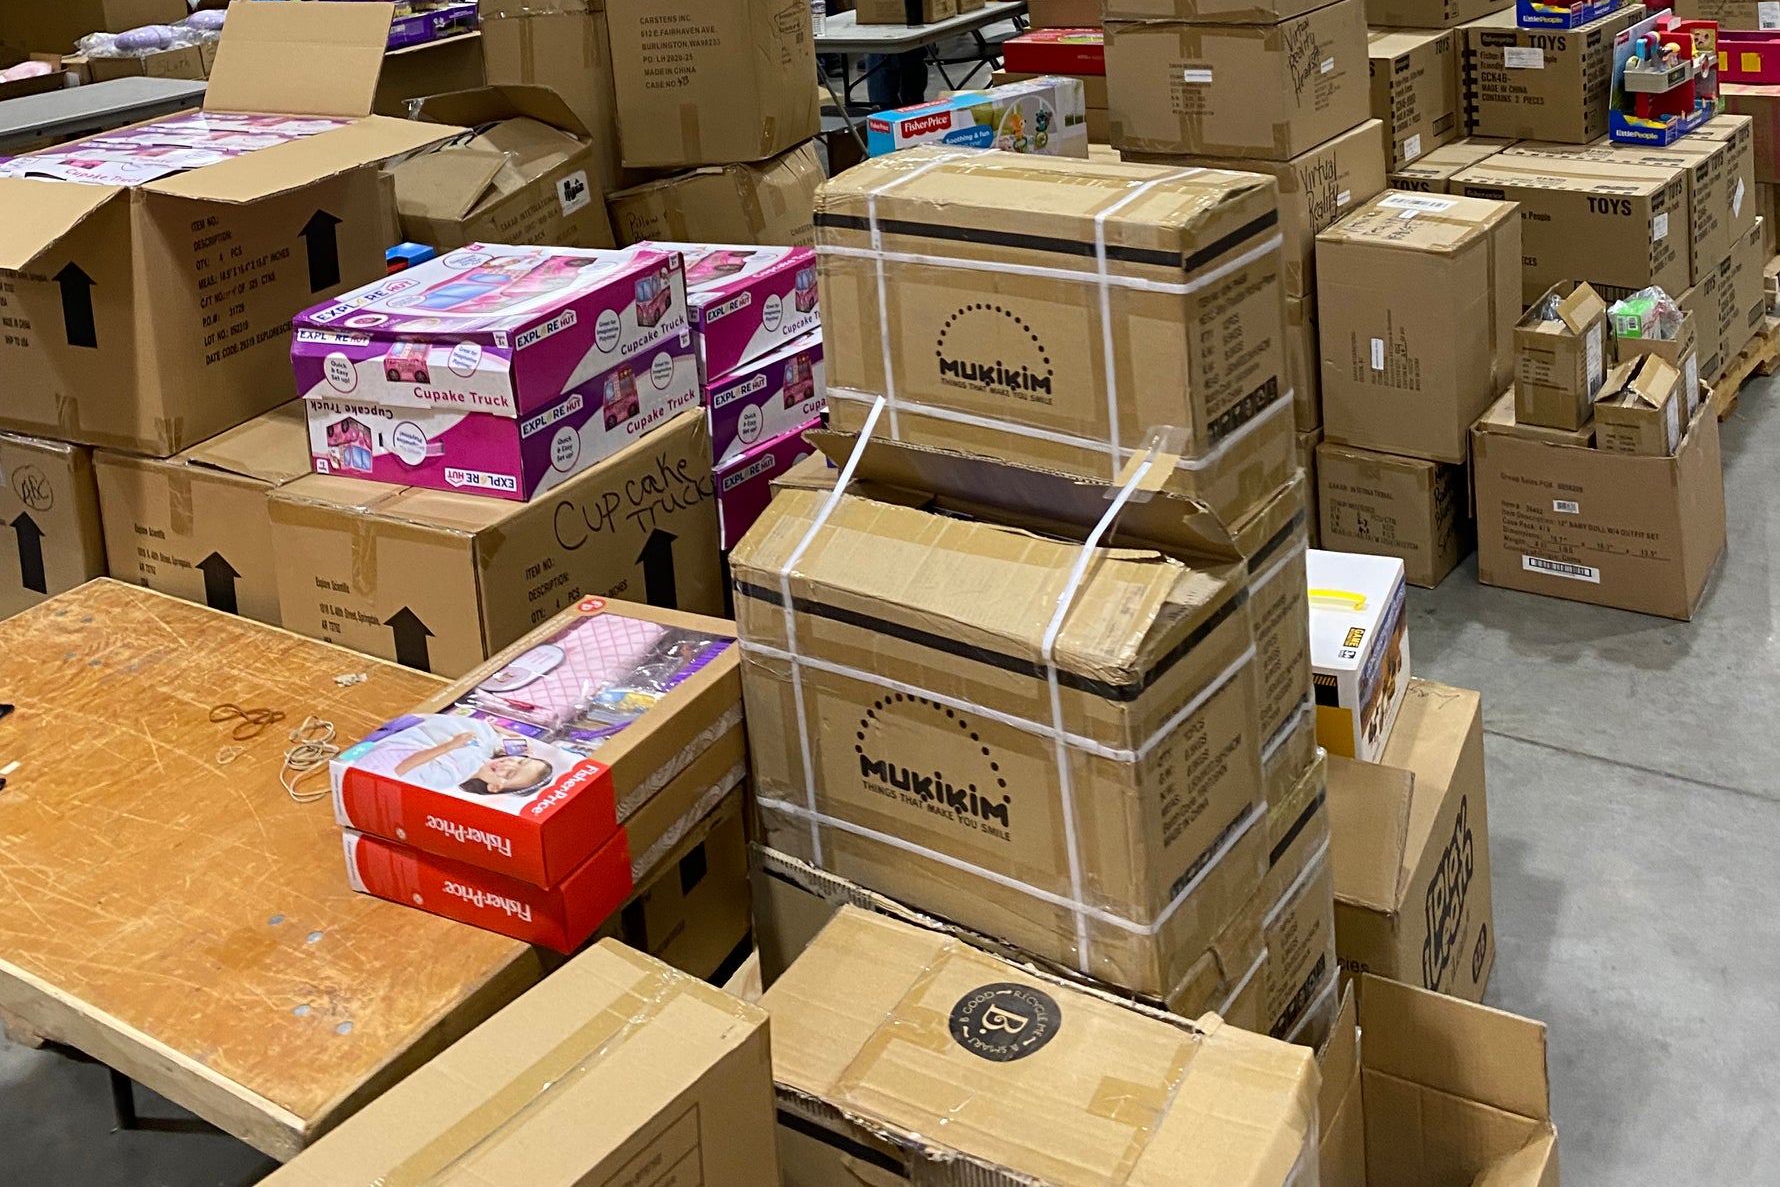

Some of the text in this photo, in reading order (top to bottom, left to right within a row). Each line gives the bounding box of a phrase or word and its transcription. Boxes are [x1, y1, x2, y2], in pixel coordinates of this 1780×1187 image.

[640, 14, 678, 25] CARSTENS
[1528, 34, 1566, 52] TOYS
[644, 68, 664, 76] MADE
[674, 66, 697, 75] CHINA
[1482, 84, 1528, 94] MADE IN CHINA
[1482, 94, 1512, 103] CONTAINS
[1523, 96, 1545, 105] PIECES
[905, 116, 948, 133] Fisher-Price
[1586, 196, 1632, 216] TOYS
[230, 245, 243, 259] PCS
[388, 279, 413, 294] HUT
[739, 296, 750, 308] HUT
[560, 314, 576, 328] HUT
[782, 316, 813, 336] Cupcake
[204, 333, 216, 347] LOT
[621, 316, 686, 356] Cupcake Truck
[205, 351, 220, 366] DATE
[752, 378, 766, 392] HUT
[413, 386, 509, 407] Cupake Truck
[310, 400, 394, 420] Cupcake Truck
[566, 399, 583, 413] HUT
[626, 390, 696, 435] Cupake Truck
[802, 397, 826, 415] Cupa
[447, 470, 465, 482] HUT
[525, 562, 541, 582] ITEM
[531, 763, 599, 817] Fisher-Price
[863, 780, 1011, 842] THINGS THAT MAKE YOU SMILE
[426, 814, 512, 858] Fisher-Price
[443, 879, 531, 922] Fisher-Price
